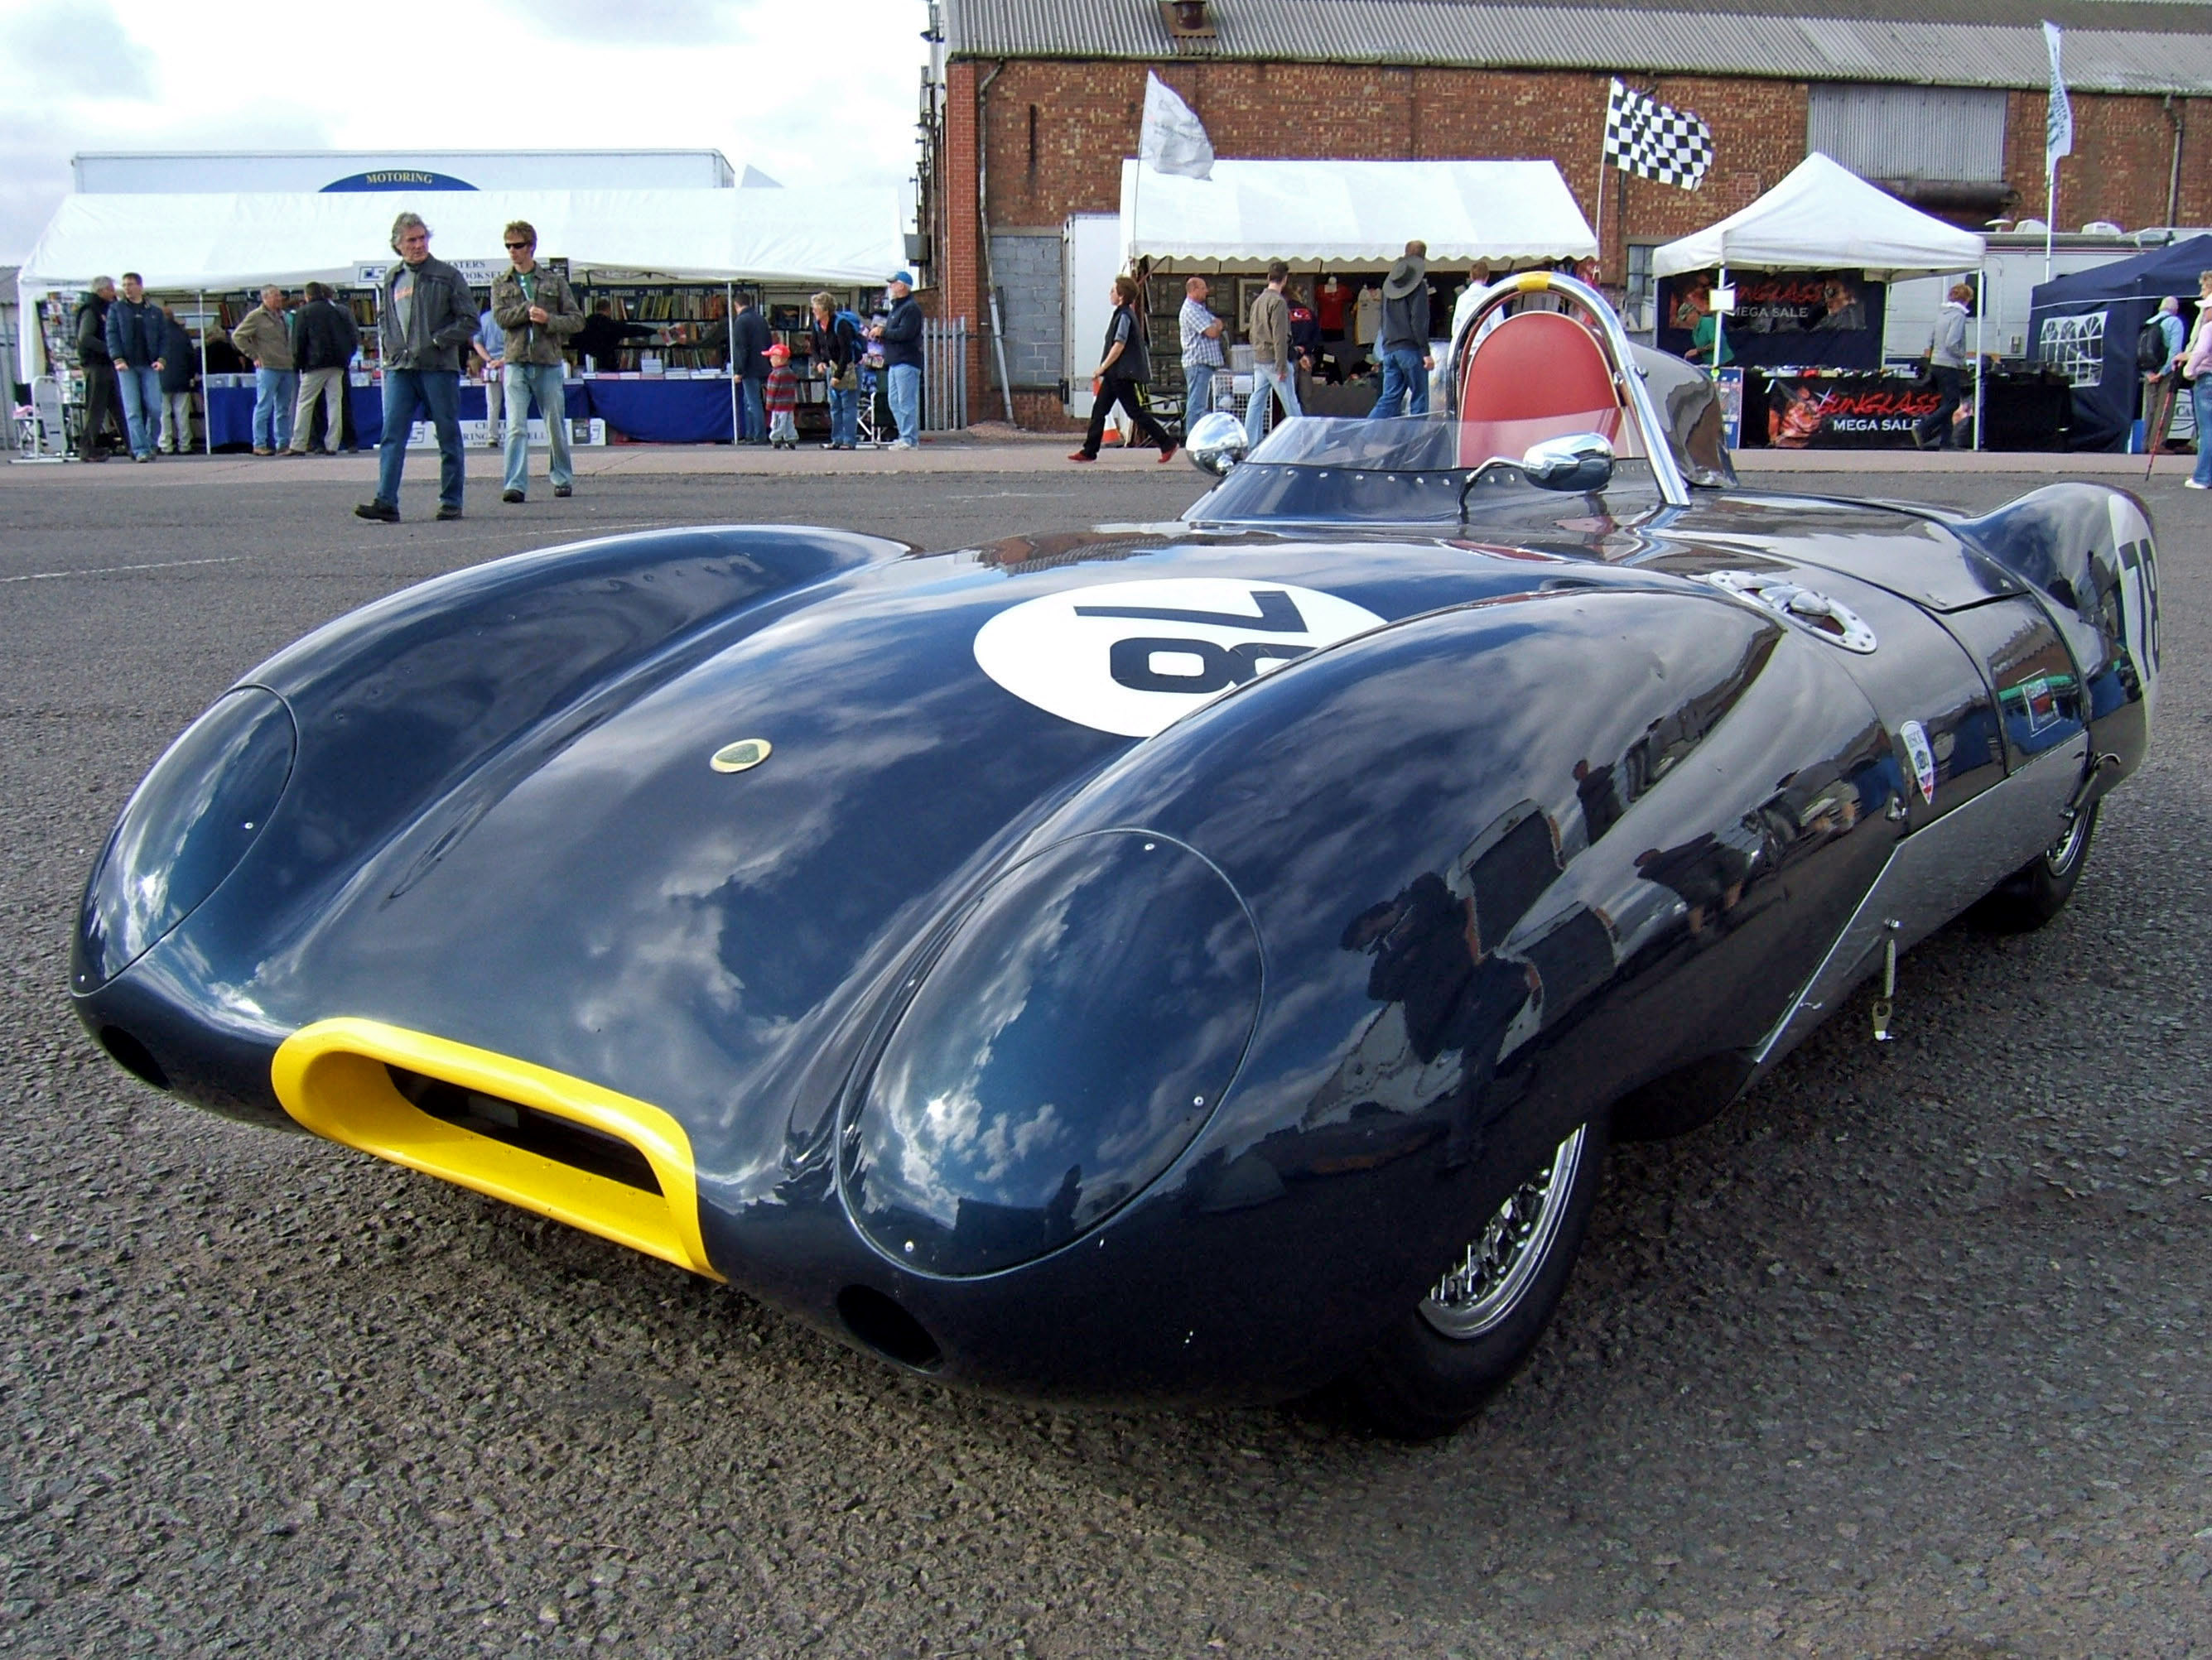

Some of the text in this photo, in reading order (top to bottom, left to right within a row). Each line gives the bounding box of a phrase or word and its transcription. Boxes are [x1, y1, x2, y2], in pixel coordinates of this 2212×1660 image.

[366, 171, 433, 184] MOTORING
[1772, 307, 1809, 318] SALE
[1817, 390, 1942, 416] SUNGLASS
[1834, 419, 1878, 431] MEGA
[1072, 589, 1323, 695] 78
